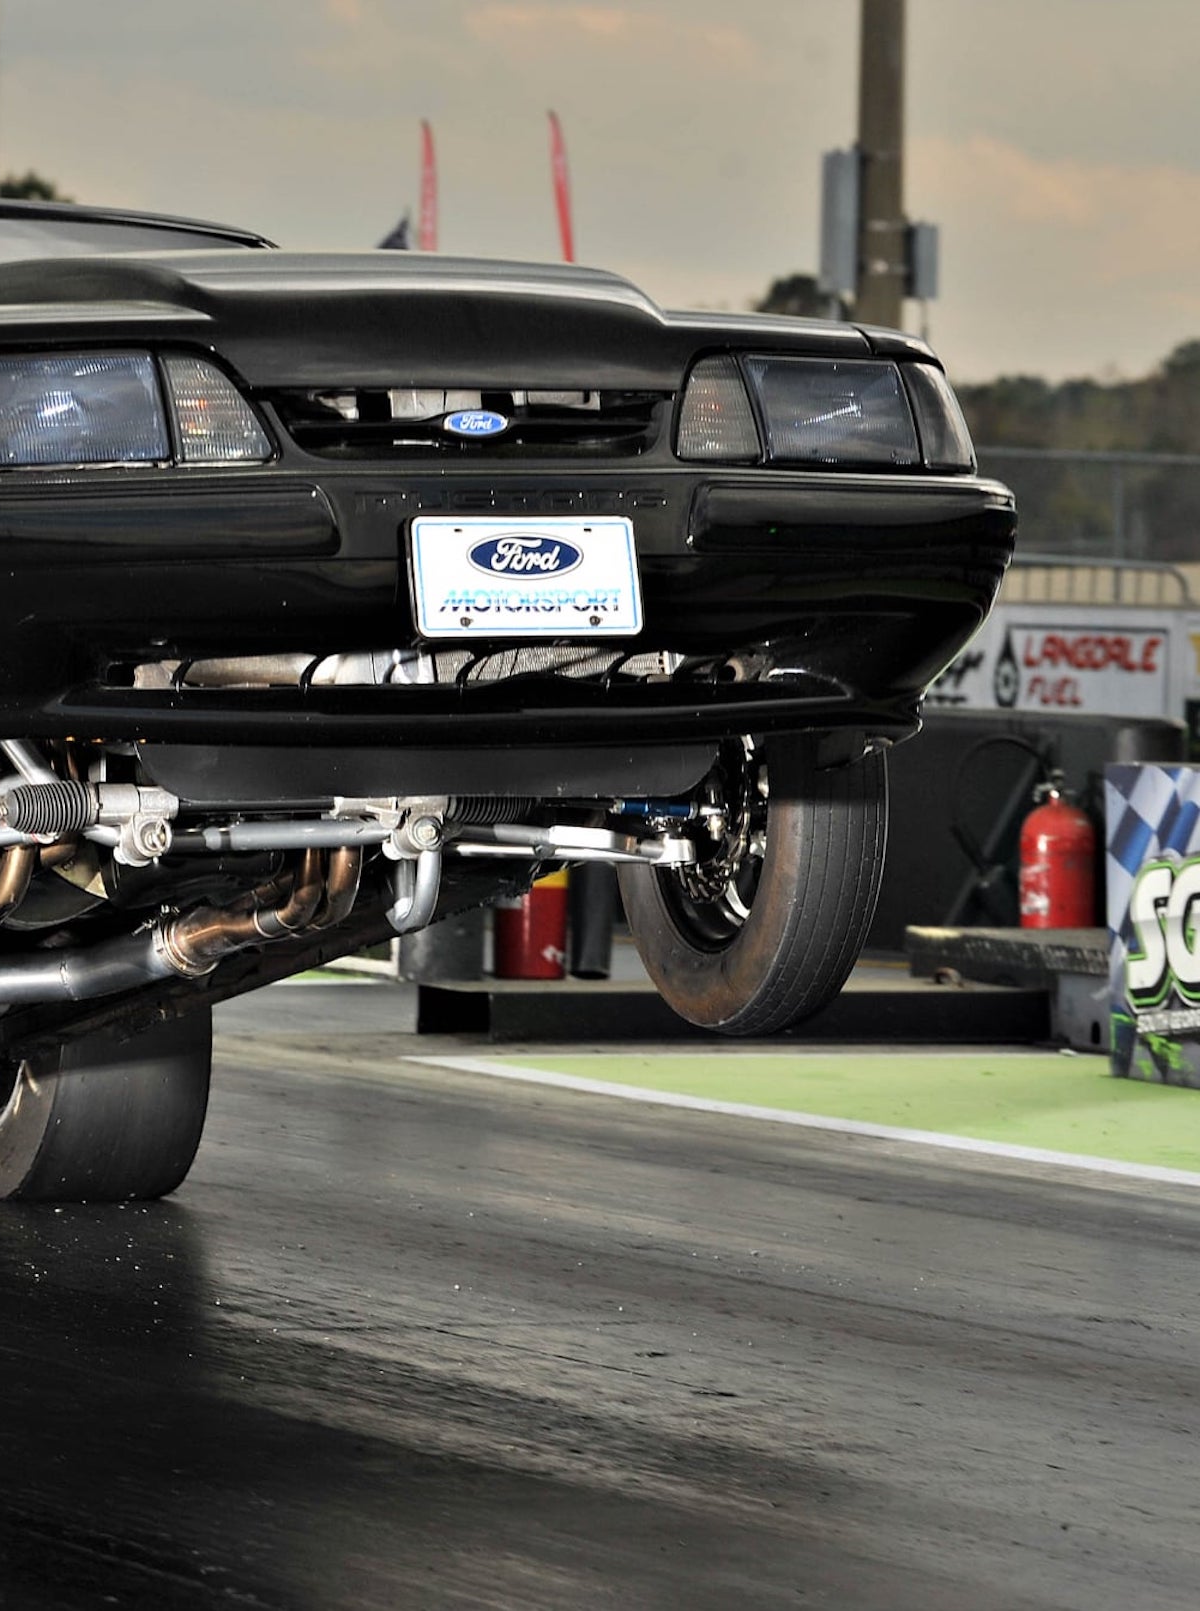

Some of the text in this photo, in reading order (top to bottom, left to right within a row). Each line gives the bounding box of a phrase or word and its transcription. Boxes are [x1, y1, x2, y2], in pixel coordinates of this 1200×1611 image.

[459, 414, 493, 430] Ford
[490, 537, 561, 571] Ford
[439, 589, 621, 612] MOTORSPORT
[1023, 634, 1163, 672] LANGDALE
[1027, 675, 1083, 707] FUEL
